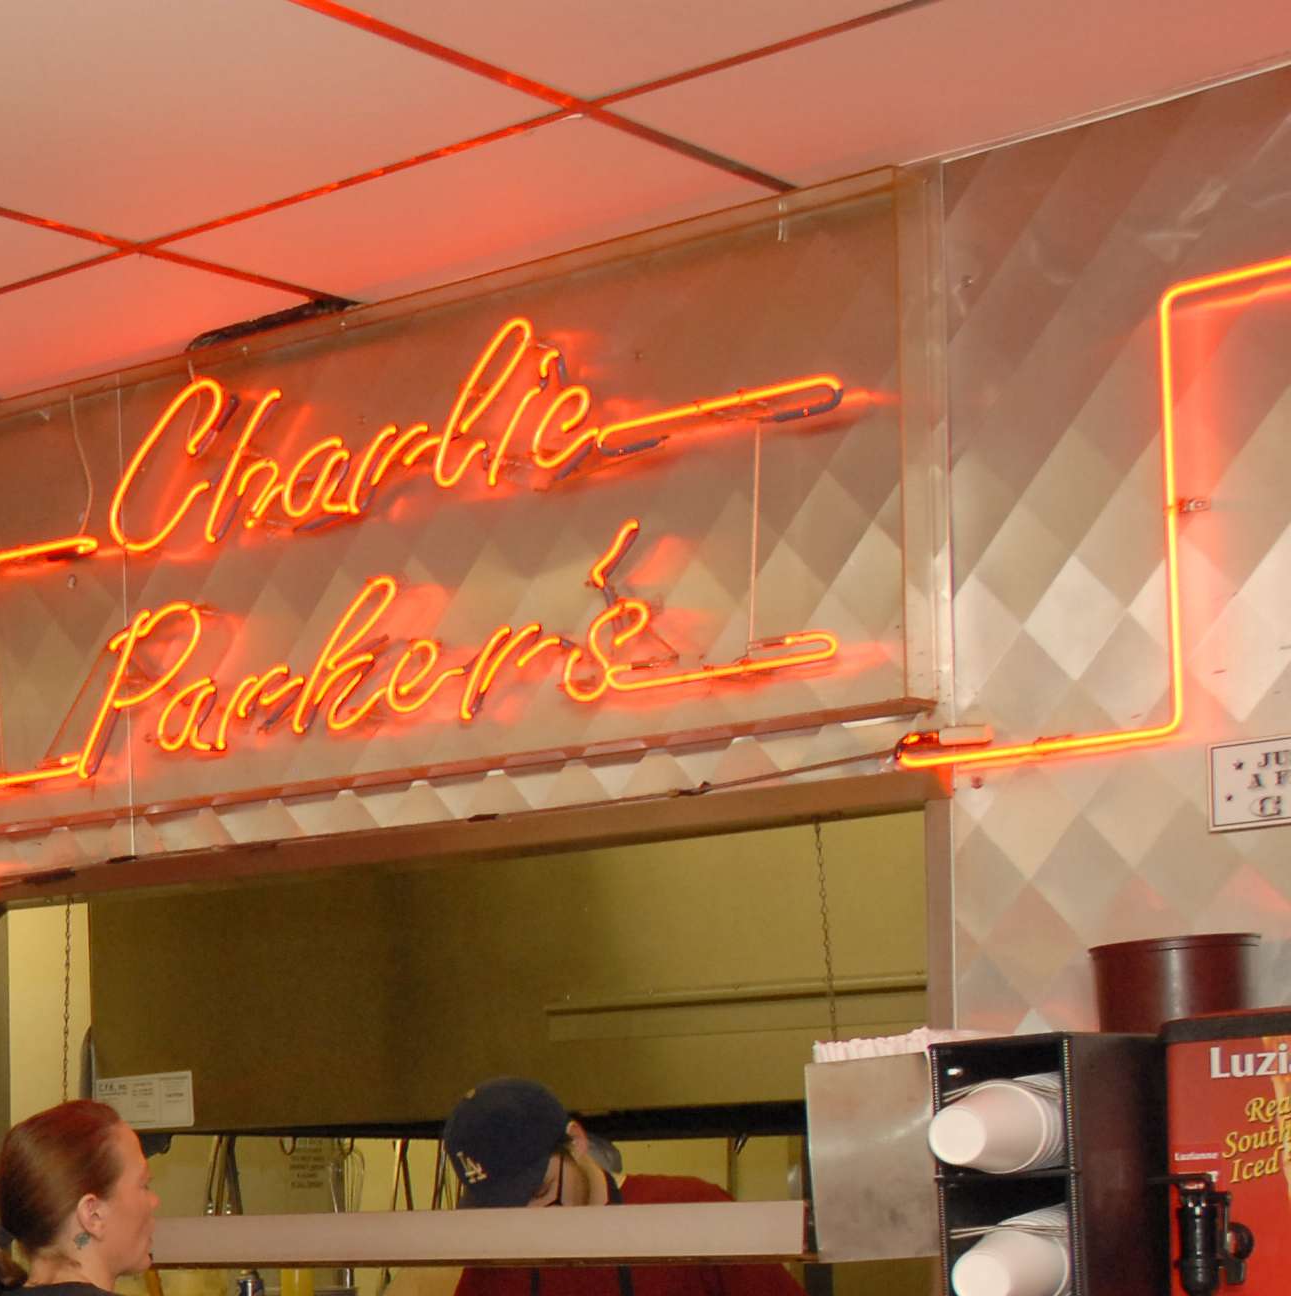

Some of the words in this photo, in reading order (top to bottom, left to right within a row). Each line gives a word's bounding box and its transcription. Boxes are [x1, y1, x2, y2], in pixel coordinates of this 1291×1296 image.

[107, 315, 609, 553] Charlie
[75, 516, 653, 780] Parker's
[1210, 1042, 1291, 1080] Luzi
[456, 1151, 488, 1184] LA
[1229, 1144, 1286, 1185] Iced
